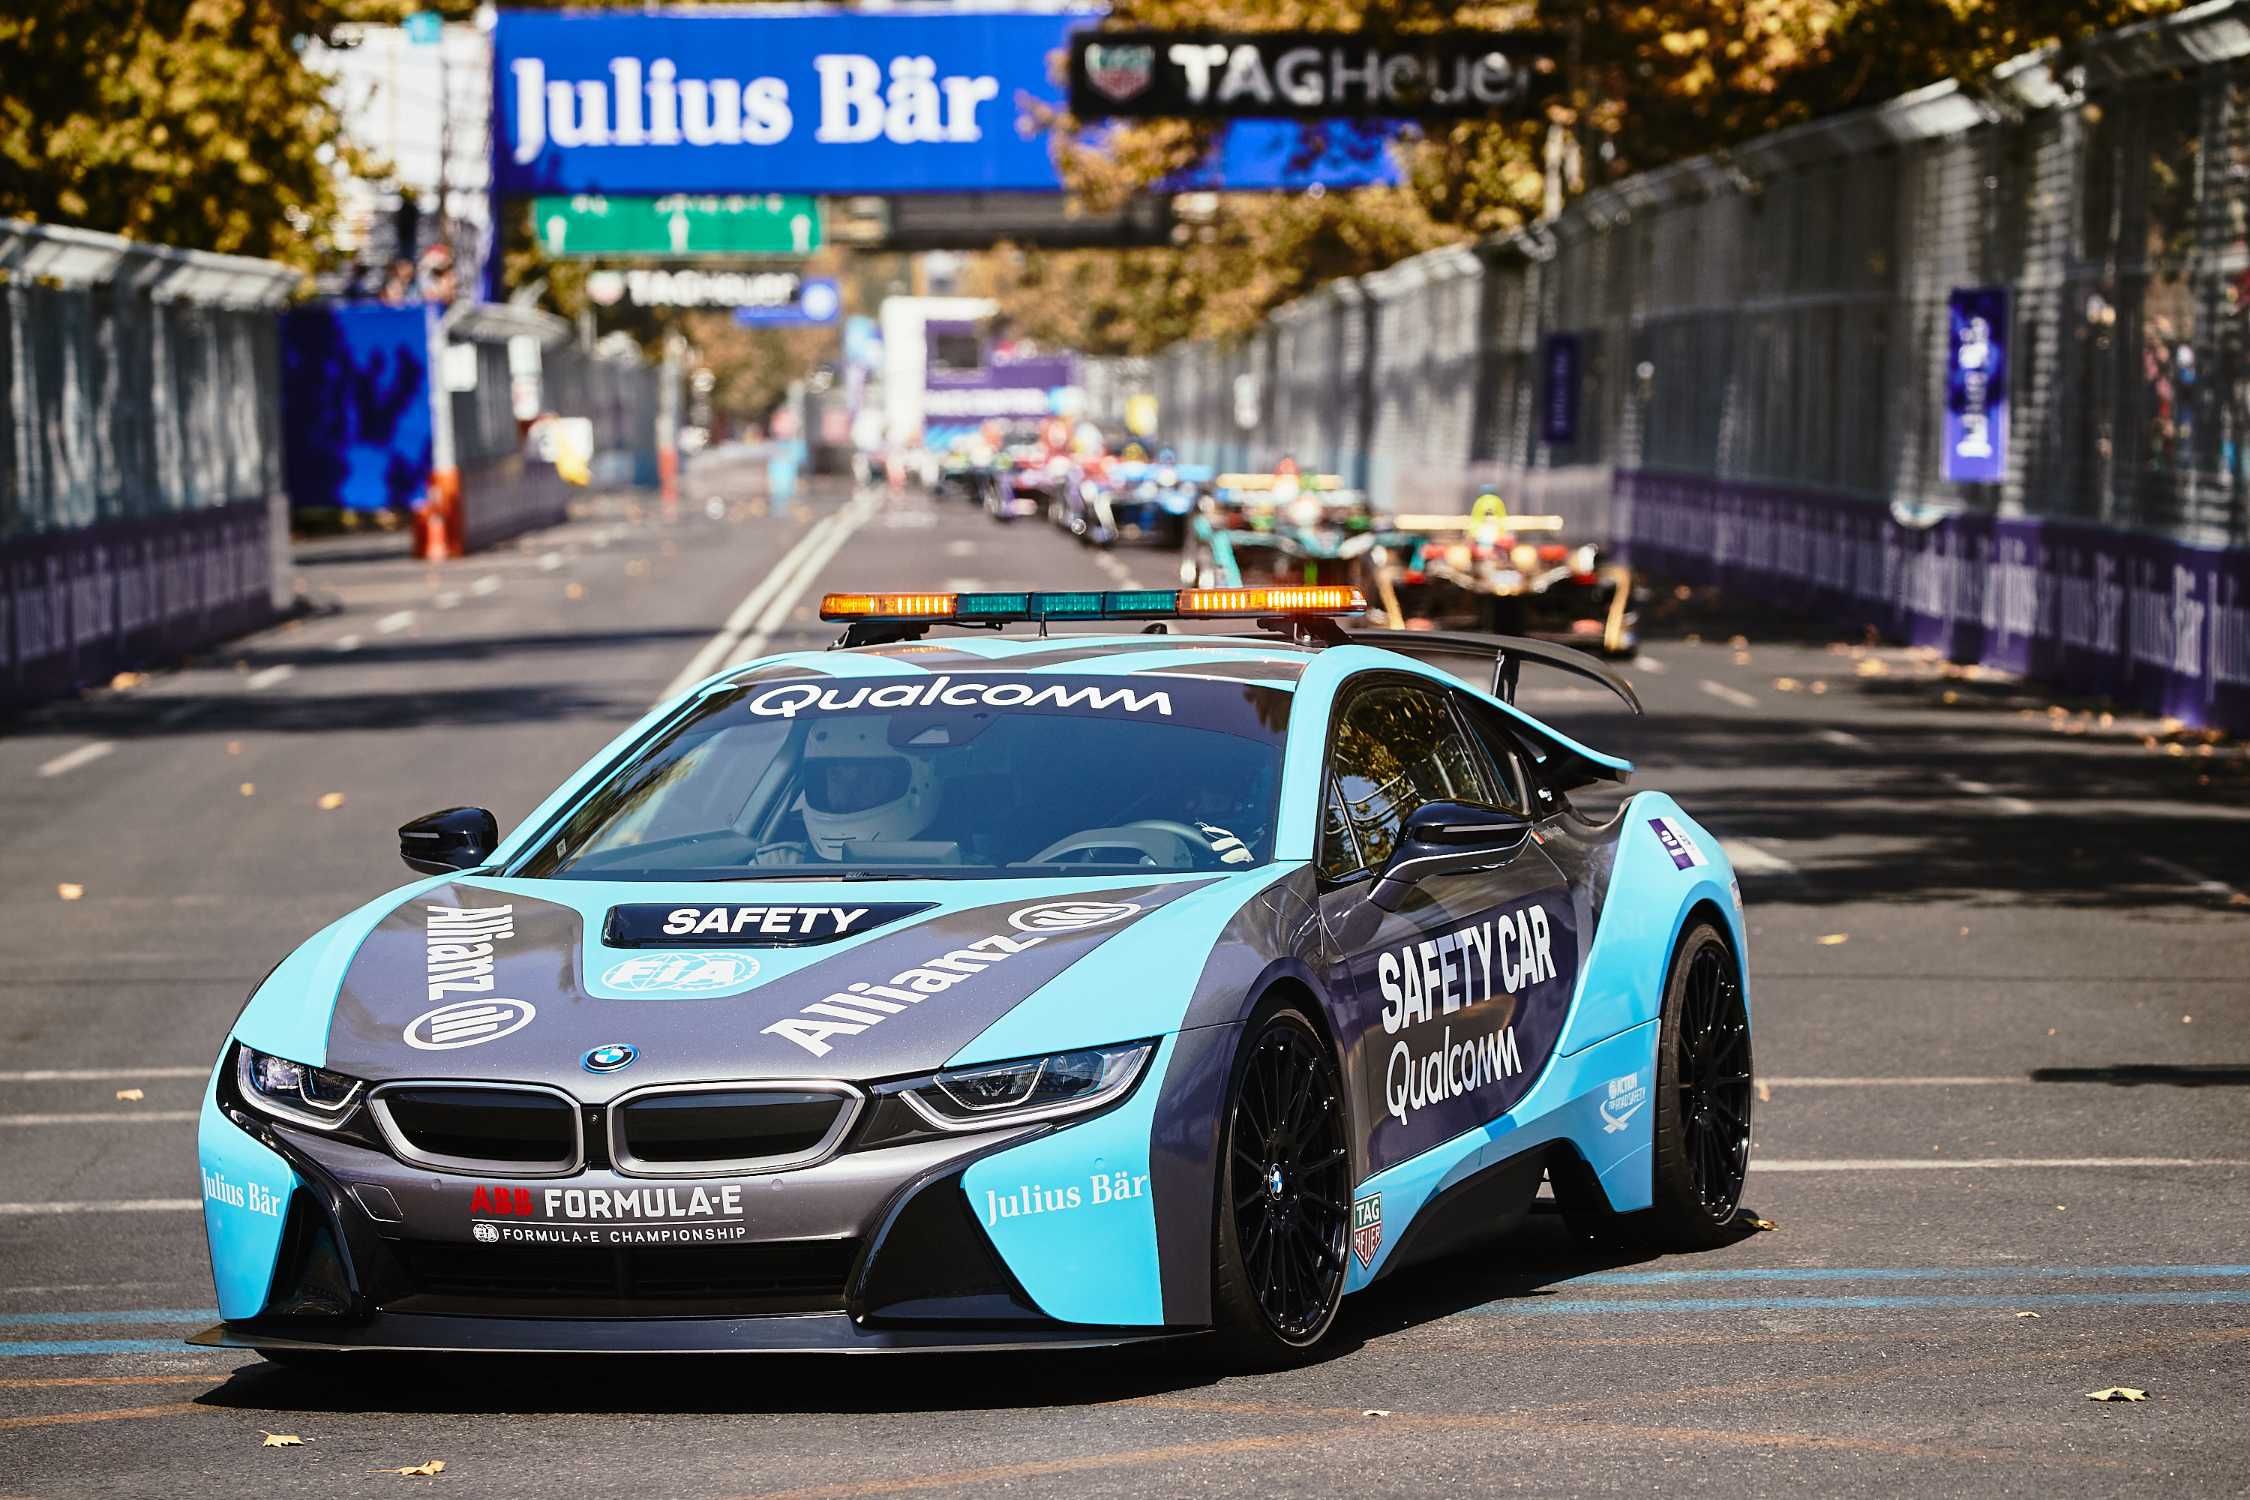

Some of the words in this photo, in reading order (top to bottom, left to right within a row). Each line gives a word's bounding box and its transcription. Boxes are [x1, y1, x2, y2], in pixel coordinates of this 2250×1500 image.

[512, 56, 794, 165] Julius
[814, 54, 999, 144] Bär
[749, 676, 1172, 718] Qualcomm
[662, 907, 870, 935] SAFETY
[427, 904, 516, 1001] Allianz
[1378, 921, 1491, 1034] SAFETY
[1498, 904, 1557, 994] CAR
[759, 934, 1048, 1058] Allianz
[1386, 1025, 1522, 1126] Qualcomm
[201, 1167, 245, 1208] Julius
[248, 1182, 280, 1217] Bär
[470, 1184, 533, 1218] ABB
[544, 1184, 744, 1219] FORMULA-E
[986, 1184, 1081, 1227] Julius
[1090, 1171, 1147, 1205] Bär
[1356, 1199, 1380, 1226] TAG
[503, 1227, 600, 1243] FORMULA-E
[610, 1226, 747, 1244] CHAMPIONSHIP
[1355, 1226, 1380, 1261] HEUER
